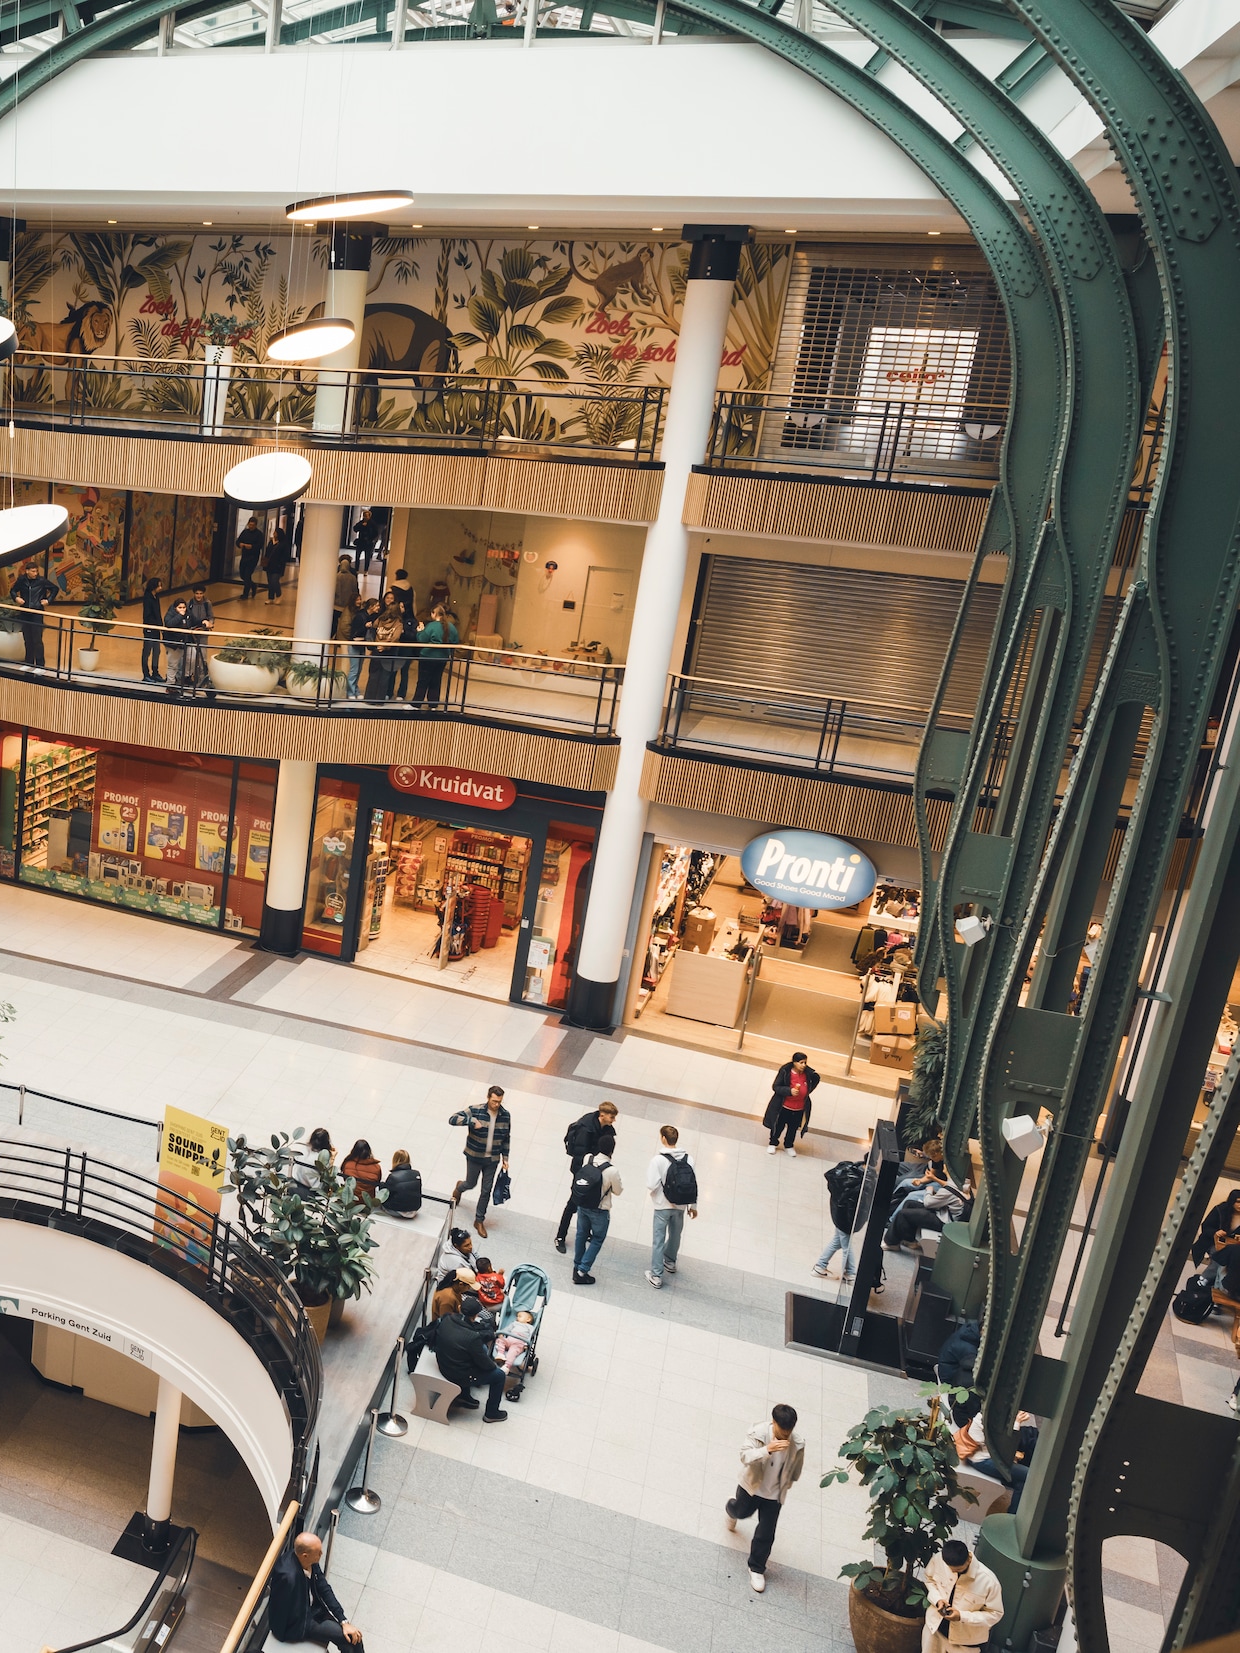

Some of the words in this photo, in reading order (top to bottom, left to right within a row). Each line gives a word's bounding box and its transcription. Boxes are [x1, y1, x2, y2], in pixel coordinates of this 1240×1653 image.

[139, 294, 174, 315] Zoek
[160, 316, 181, 337] de
[585, 311, 633, 336] Zoek
[612, 338, 638, 361] de
[419, 769, 504, 803] Kruidvat
[104, 791, 139, 807] PROMO!
[151, 799, 187, 815] PROMO!
[200, 810, 238, 825] PROM!
[755, 838, 861, 893] Pronti
[754, 878, 776, 888] Good
[776, 882, 798, 893] Shoes
[800, 887, 822, 898] Good
[823, 892, 846, 902] Mood
[210, 1126, 226, 1137] GENT
[168, 1132, 204, 1155] SOUND
[31, 1307, 66, 1325] Parking
[68, 1319, 90, 1334] Gent
[92, 1328, 112, 1343] Zuid
[130, 1343, 145, 1356] GENT
